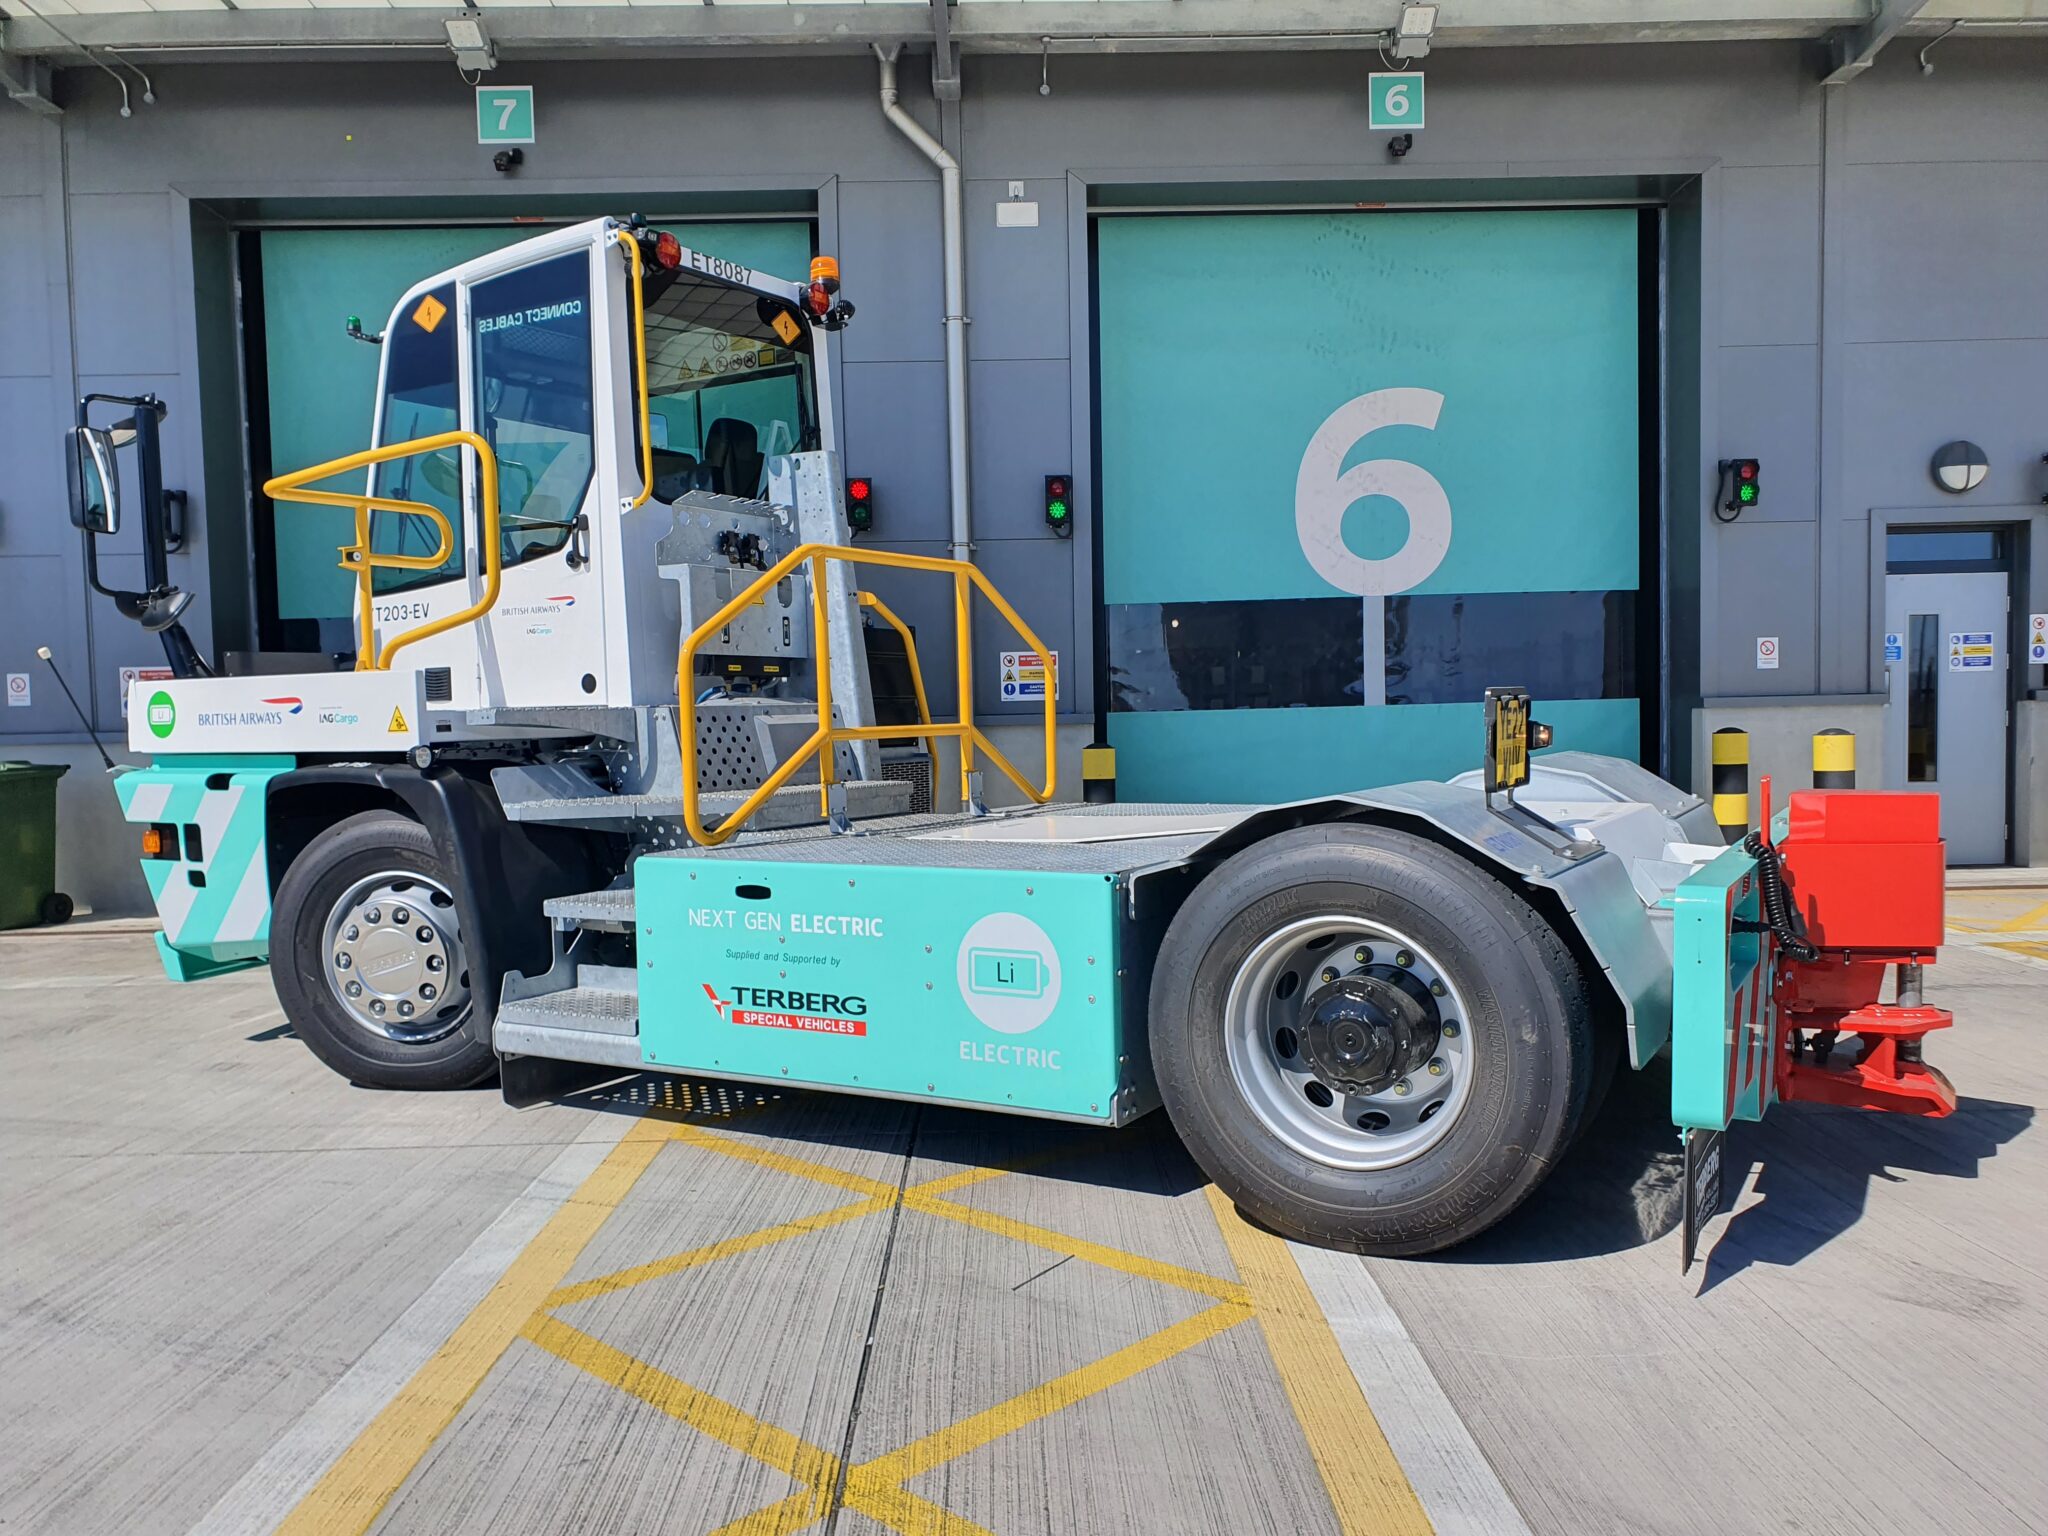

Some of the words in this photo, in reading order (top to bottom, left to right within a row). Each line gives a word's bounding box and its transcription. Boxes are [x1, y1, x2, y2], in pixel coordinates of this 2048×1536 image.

[493, 99, 517, 131] 7
[1385, 84, 1409, 117] 6
[691, 250, 752, 285] ET8087
[1295, 387, 1452, 596] 6
[371, 602, 430, 622] T203-EV
[501, 607, 529, 616] BRITISH
[530, 605, 561, 615] AIRWAYS
[198, 713, 236, 727] BRITISH
[239, 711, 282, 725] AIRWAYS
[688, 908, 737, 928] NEXT
[744, 911, 780, 931] GEN
[790, 914, 884, 937] ELECTRIC
[726, 949, 760, 961] Supplied
[763, 952, 779, 961] and
[782, 953, 827, 965] Supported
[830, 956, 841, 968] by
[997, 961, 1014, 983] Li
[730, 986, 867, 1016] TERBERG
[743, 1012, 793, 1028] SPECIAL
[796, 1017, 855, 1033] VEHICLES
[959, 1040, 1062, 1070] ELECTRIC
